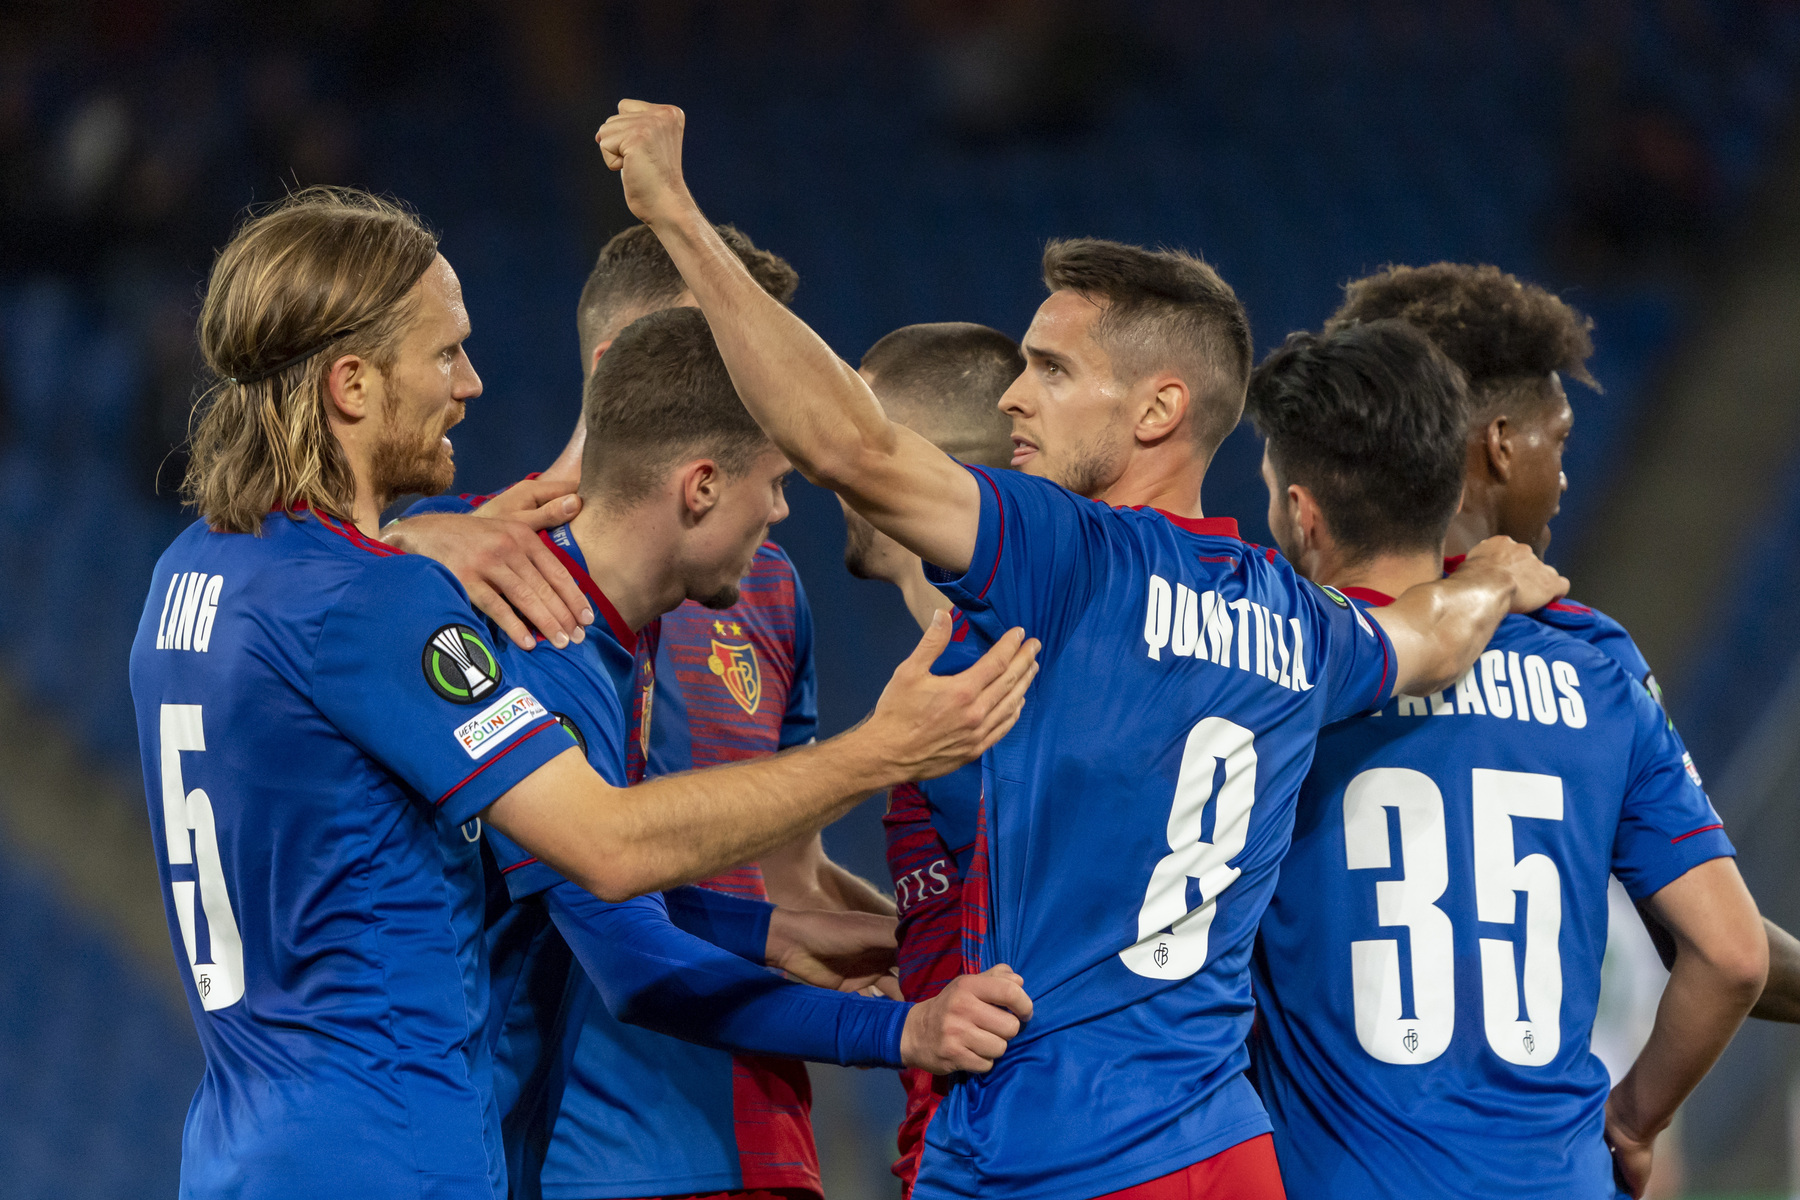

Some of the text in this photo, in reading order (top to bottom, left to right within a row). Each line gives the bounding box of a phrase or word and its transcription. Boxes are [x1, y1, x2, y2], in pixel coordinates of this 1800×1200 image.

[156, 572, 224, 653] LANG
[1144, 574, 1315, 692] QUINTILLA
[458, 720, 480, 738] UEFA
[1370, 649, 1588, 729] ACIOS
[160, 704, 245, 1012] 5
[894, 860, 950, 915] TIS
[1118, 716, 1258, 980] 8
[1343, 767, 1564, 1067] 35
